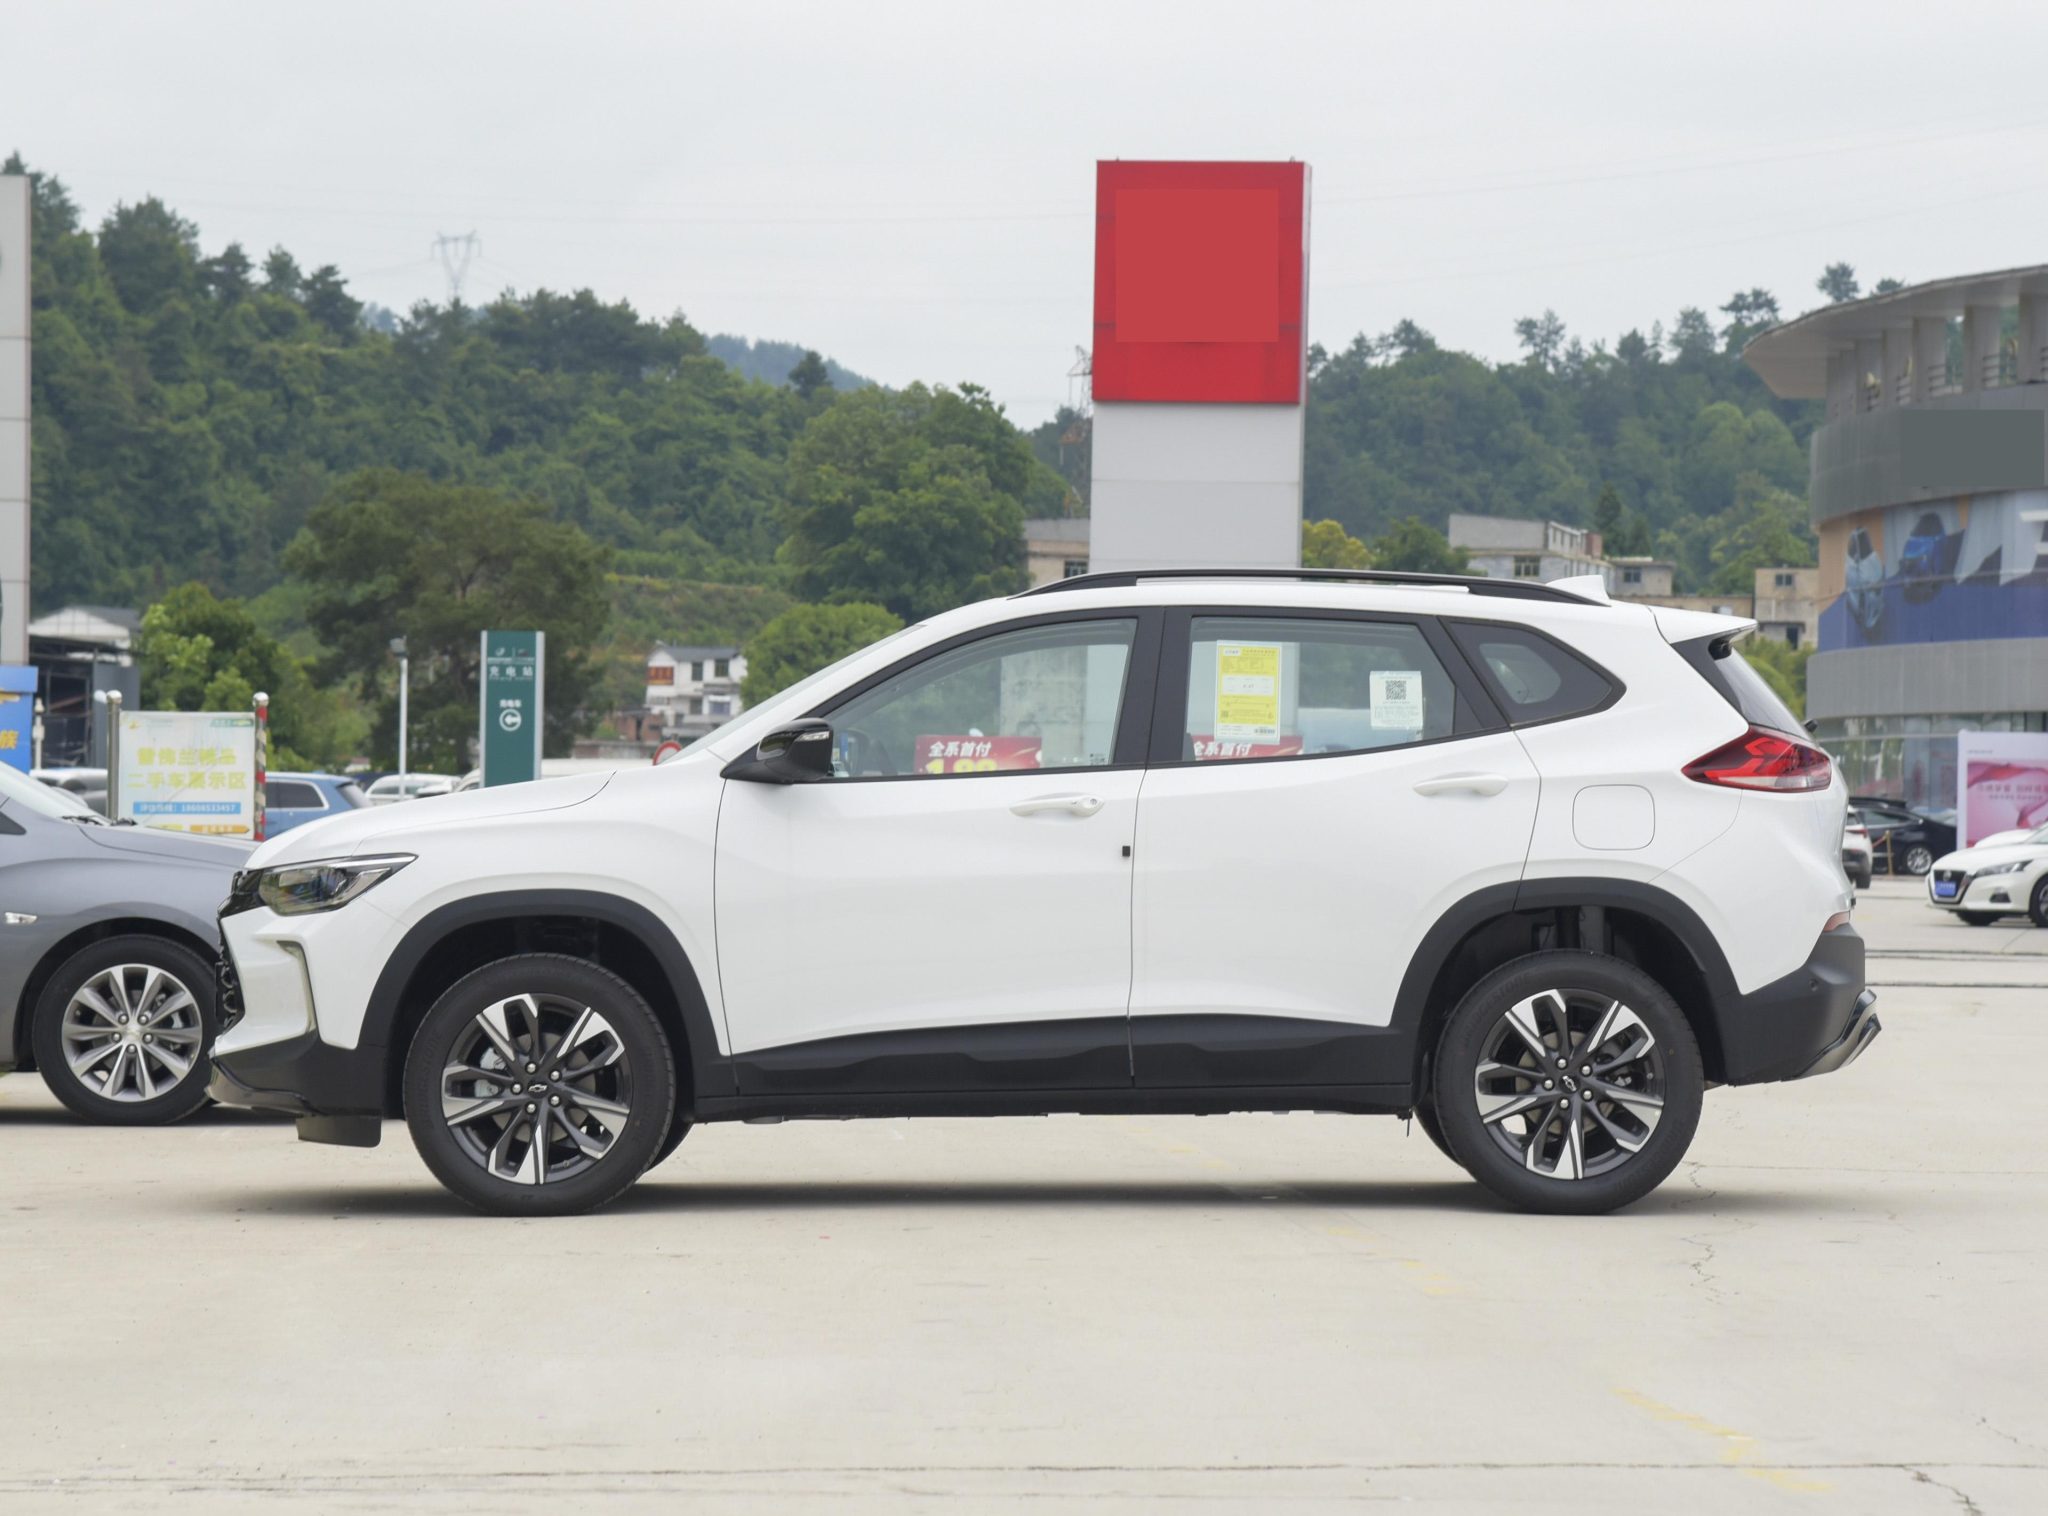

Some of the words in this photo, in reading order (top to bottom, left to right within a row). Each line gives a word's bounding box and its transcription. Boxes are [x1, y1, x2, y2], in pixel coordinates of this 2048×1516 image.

[489, 665, 533, 678] 充电站
[928, 740, 992, 757] 全系首付
[127, 771, 247, 789] 二手车展示区
